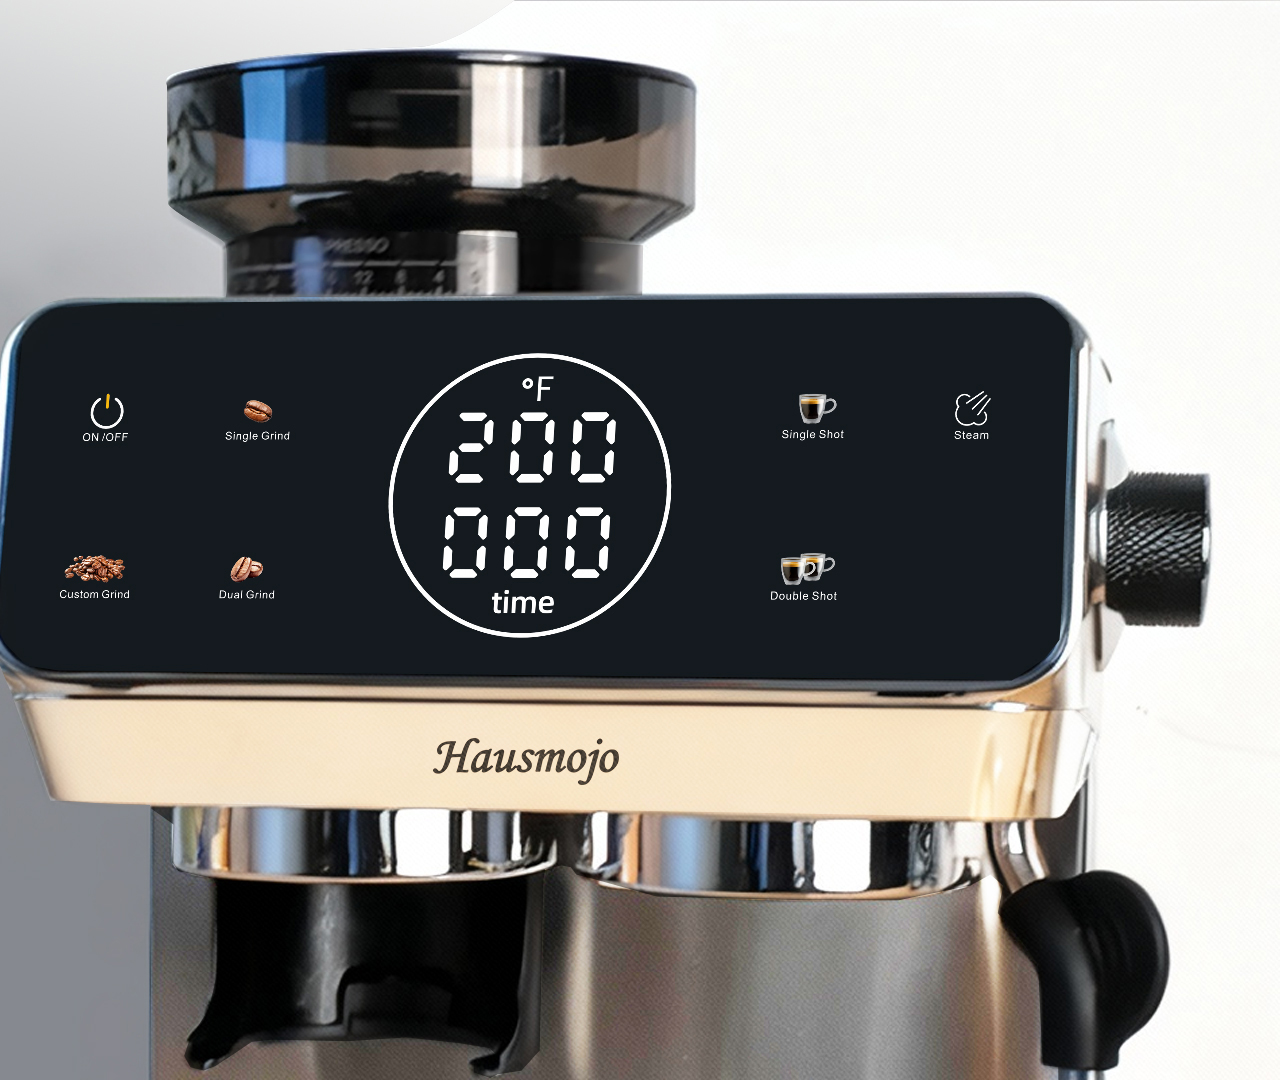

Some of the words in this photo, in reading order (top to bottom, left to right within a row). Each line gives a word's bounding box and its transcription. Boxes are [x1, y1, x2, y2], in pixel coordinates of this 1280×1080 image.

[522, 375, 555, 402] °F
[82, 432, 100, 442] ON
[101, 432, 129, 442] /OFF
[224, 431, 259, 443] Single
[261, 431, 291, 441] Grind
[781, 429, 816, 441] Single
[818, 429, 845, 439] Shot
[953, 430, 990, 440] Steam
[448, 411, 617, 484] 200
[442, 506, 611, 579] 000
[59, 589, 99, 599] Custom
[101, 589, 130, 599] Grind
[218, 589, 244, 600] Dual
[245, 589, 275, 600] Grind
[770, 590, 809, 601] Double
[811, 590, 838, 601] Shot
[491, 589, 555, 614] time
[432, 737, 620, 786] Hausmojo
